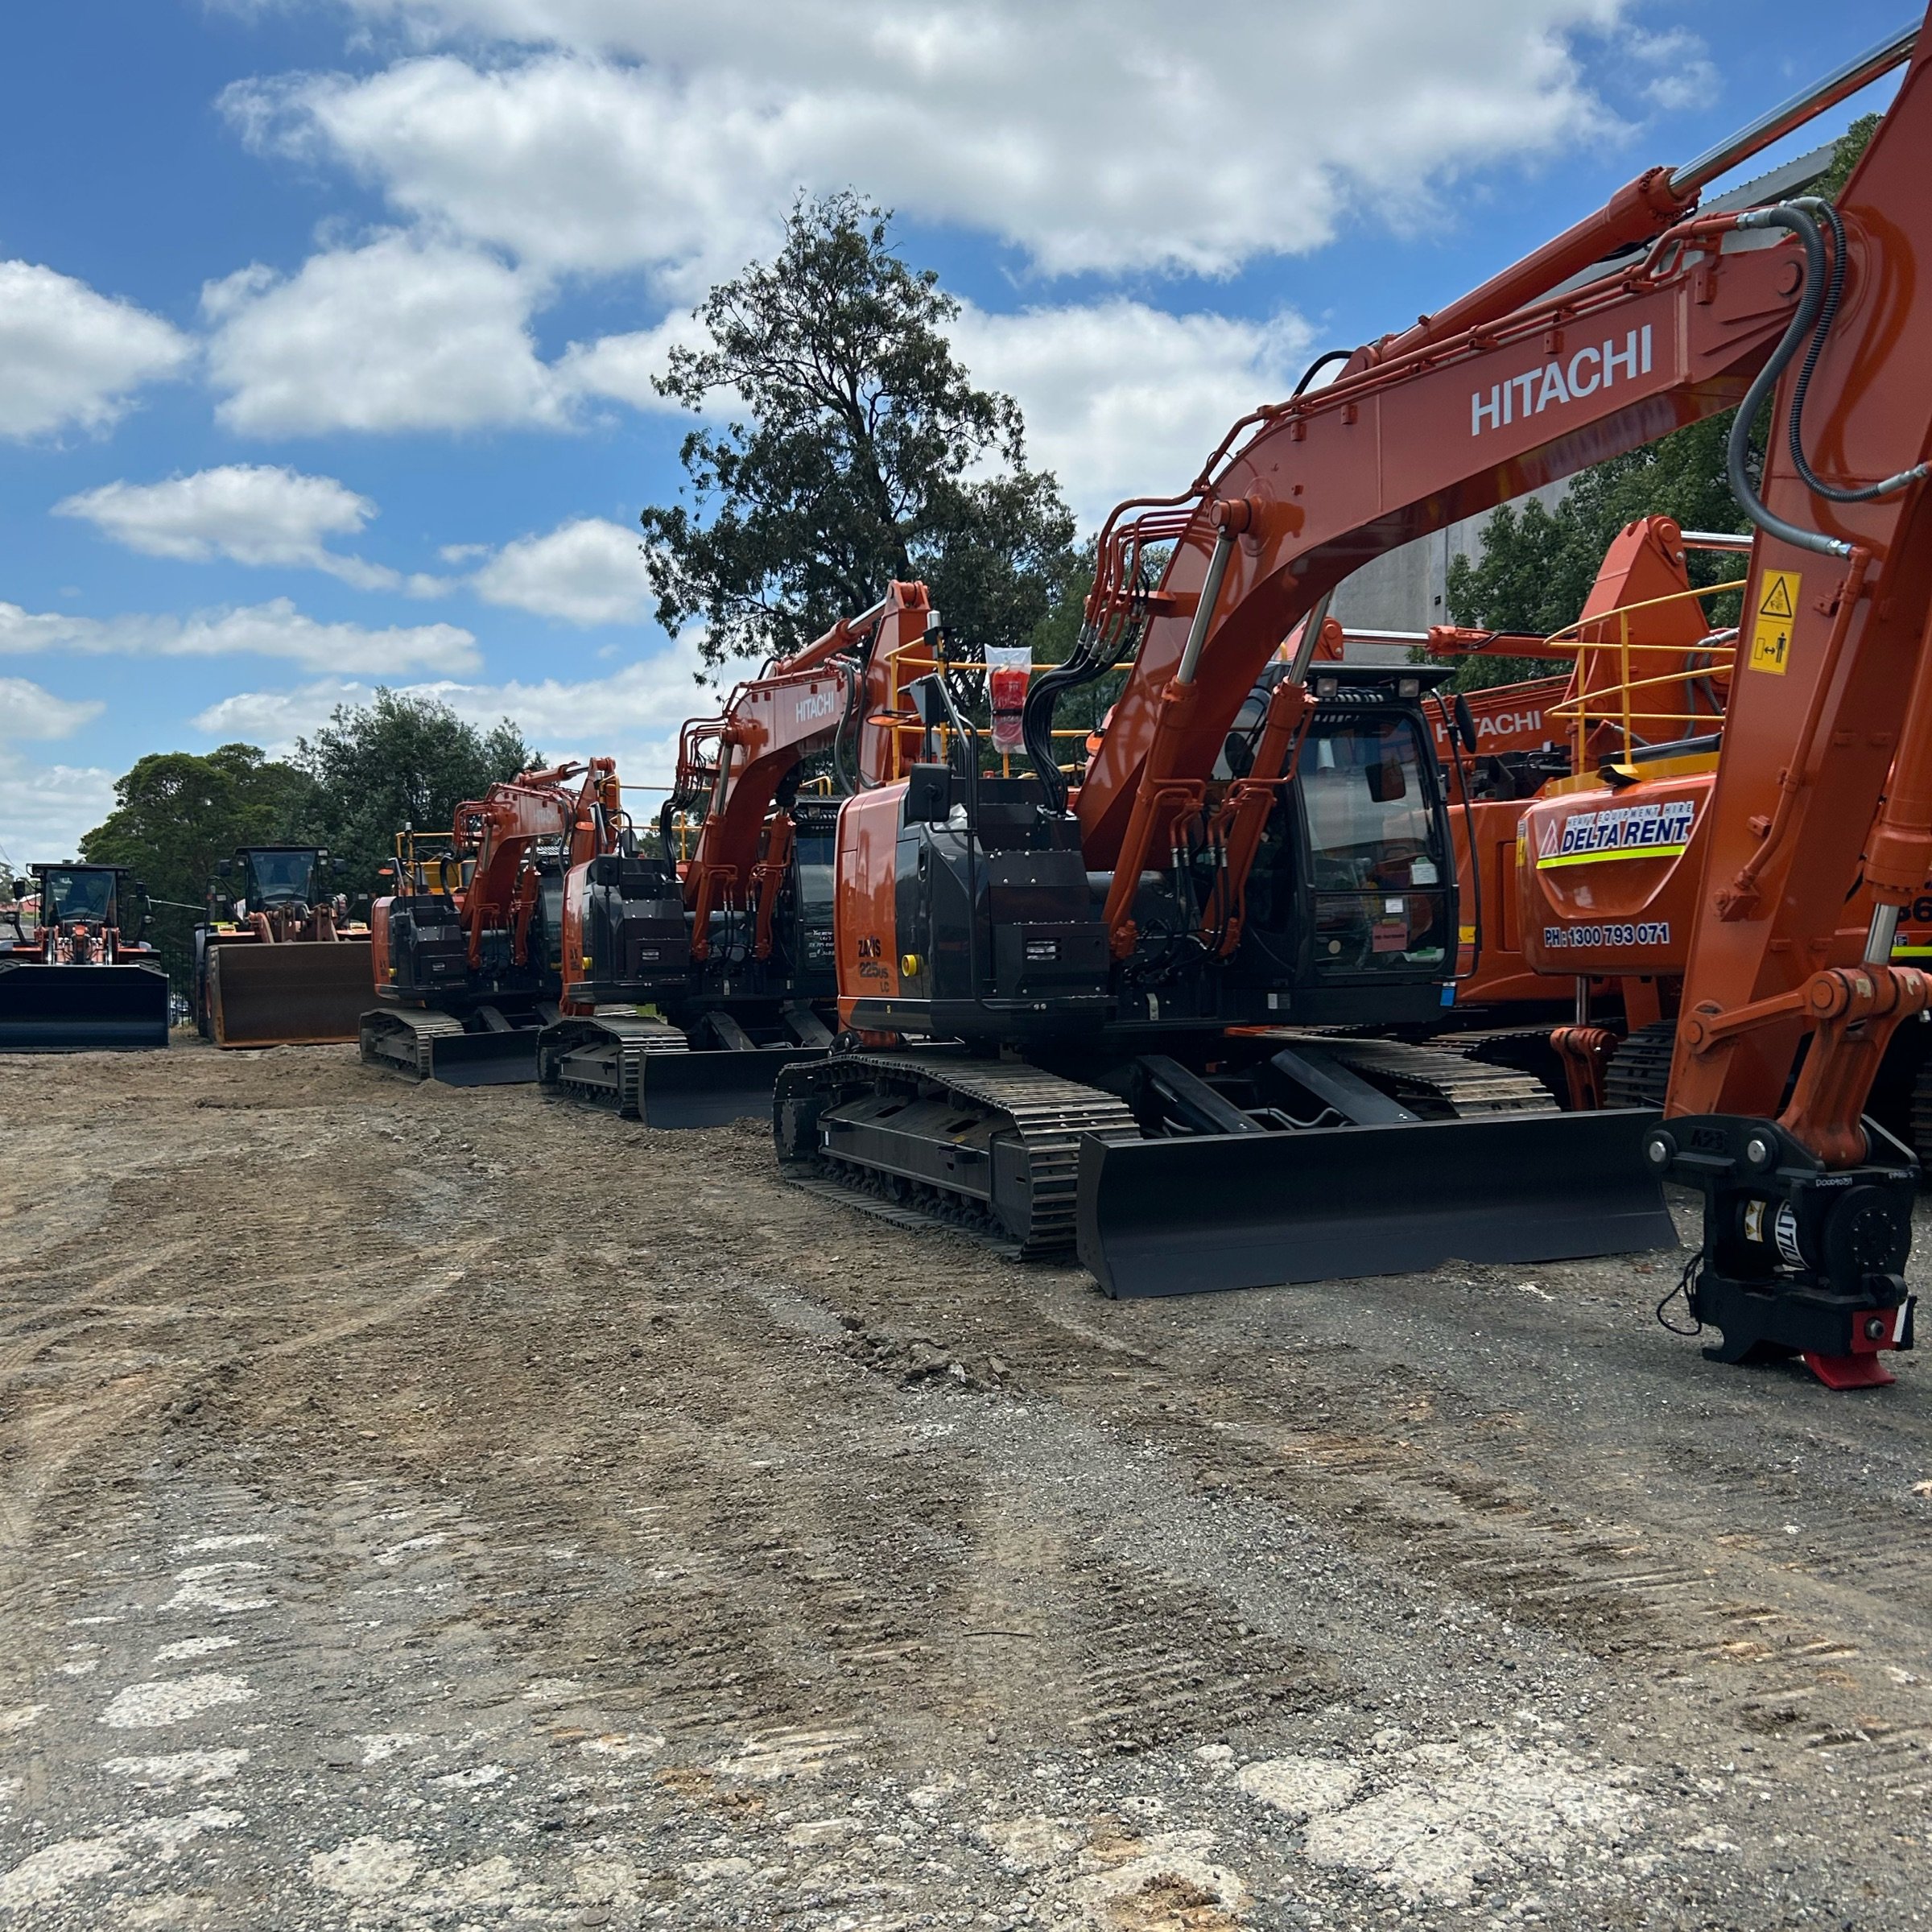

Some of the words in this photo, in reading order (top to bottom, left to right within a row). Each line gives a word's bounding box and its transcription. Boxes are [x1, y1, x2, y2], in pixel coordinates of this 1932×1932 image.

[1472, 324, 1652, 437] HITACHI
[795, 691, 834, 724] HITACHI
[1567, 814, 1595, 828] HEAVY
[1598, 806, 1659, 823] EQUIPMENT
[1664, 803, 1693, 815] HIRE
[1562, 823, 1619, 852] DELTA
[1624, 816, 1692, 845] RENT
[858, 939, 881, 957] ZAXIS
[1568, 926, 1602, 947] 1300
[1603, 924, 1634, 946] 793
[1637, 923, 1670, 944] 071
